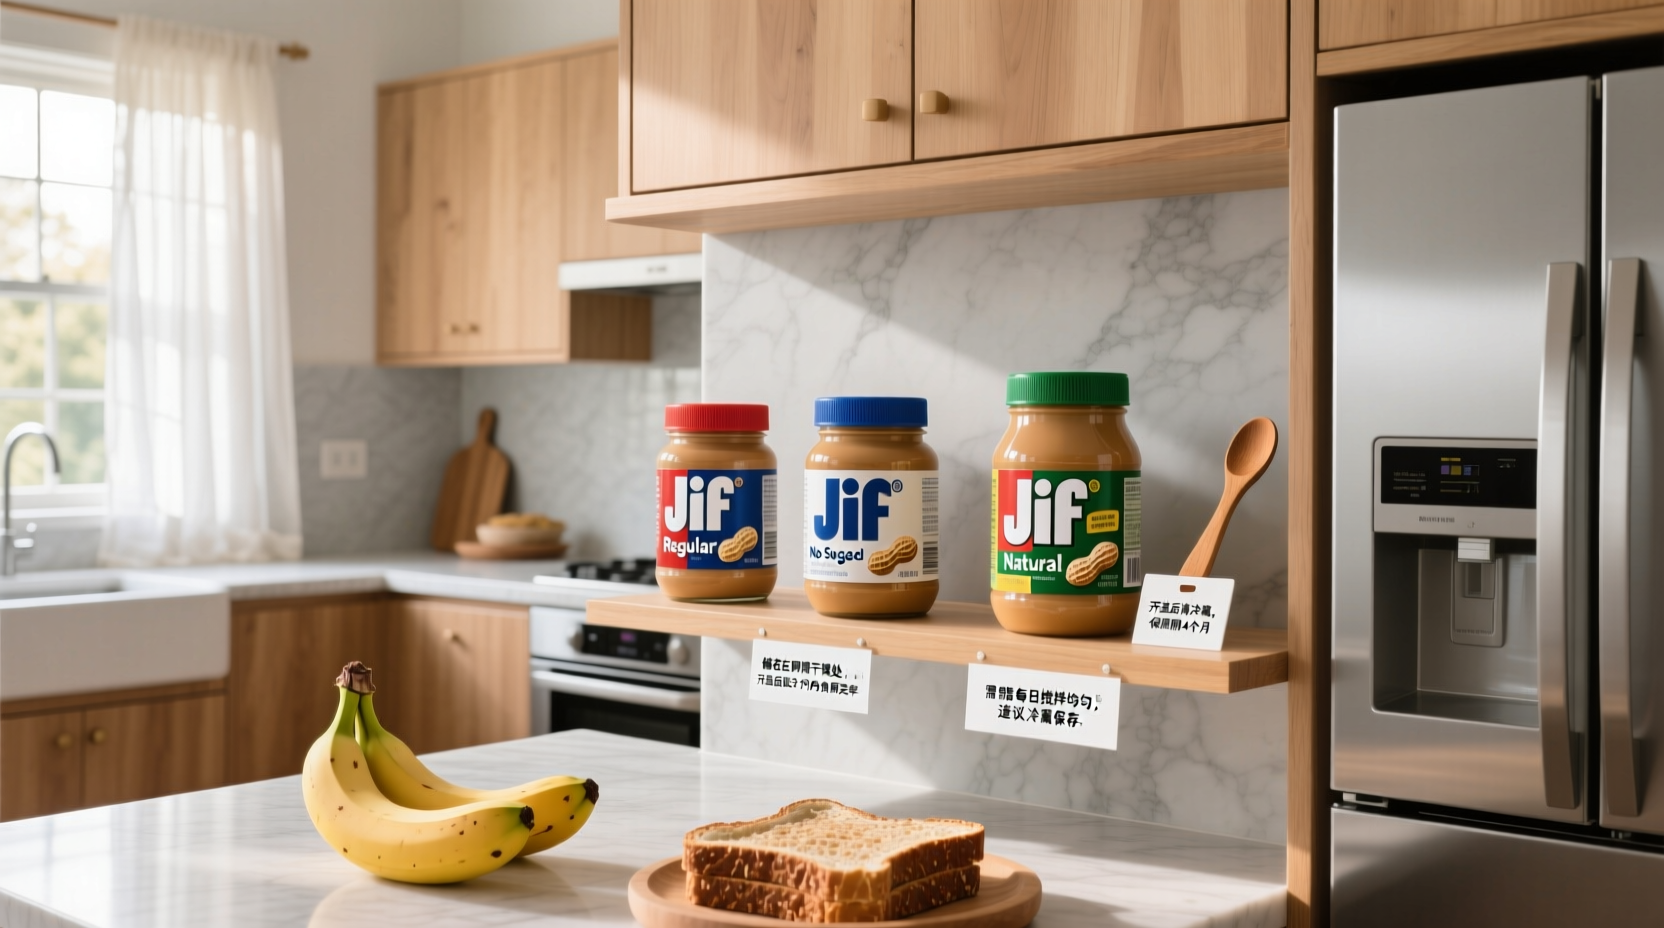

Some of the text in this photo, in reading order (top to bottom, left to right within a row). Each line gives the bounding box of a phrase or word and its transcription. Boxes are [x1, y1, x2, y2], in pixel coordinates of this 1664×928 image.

[664, 475, 735, 532] Jif
[814, 478, 892, 541] Jif
[1003, 478, 1088, 545] Jif
[663, 536, 717, 558] Regular
[810, 545, 822, 559] No
[824, 547, 864, 565] Suged
[1003, 552, 1062, 573] Natural
